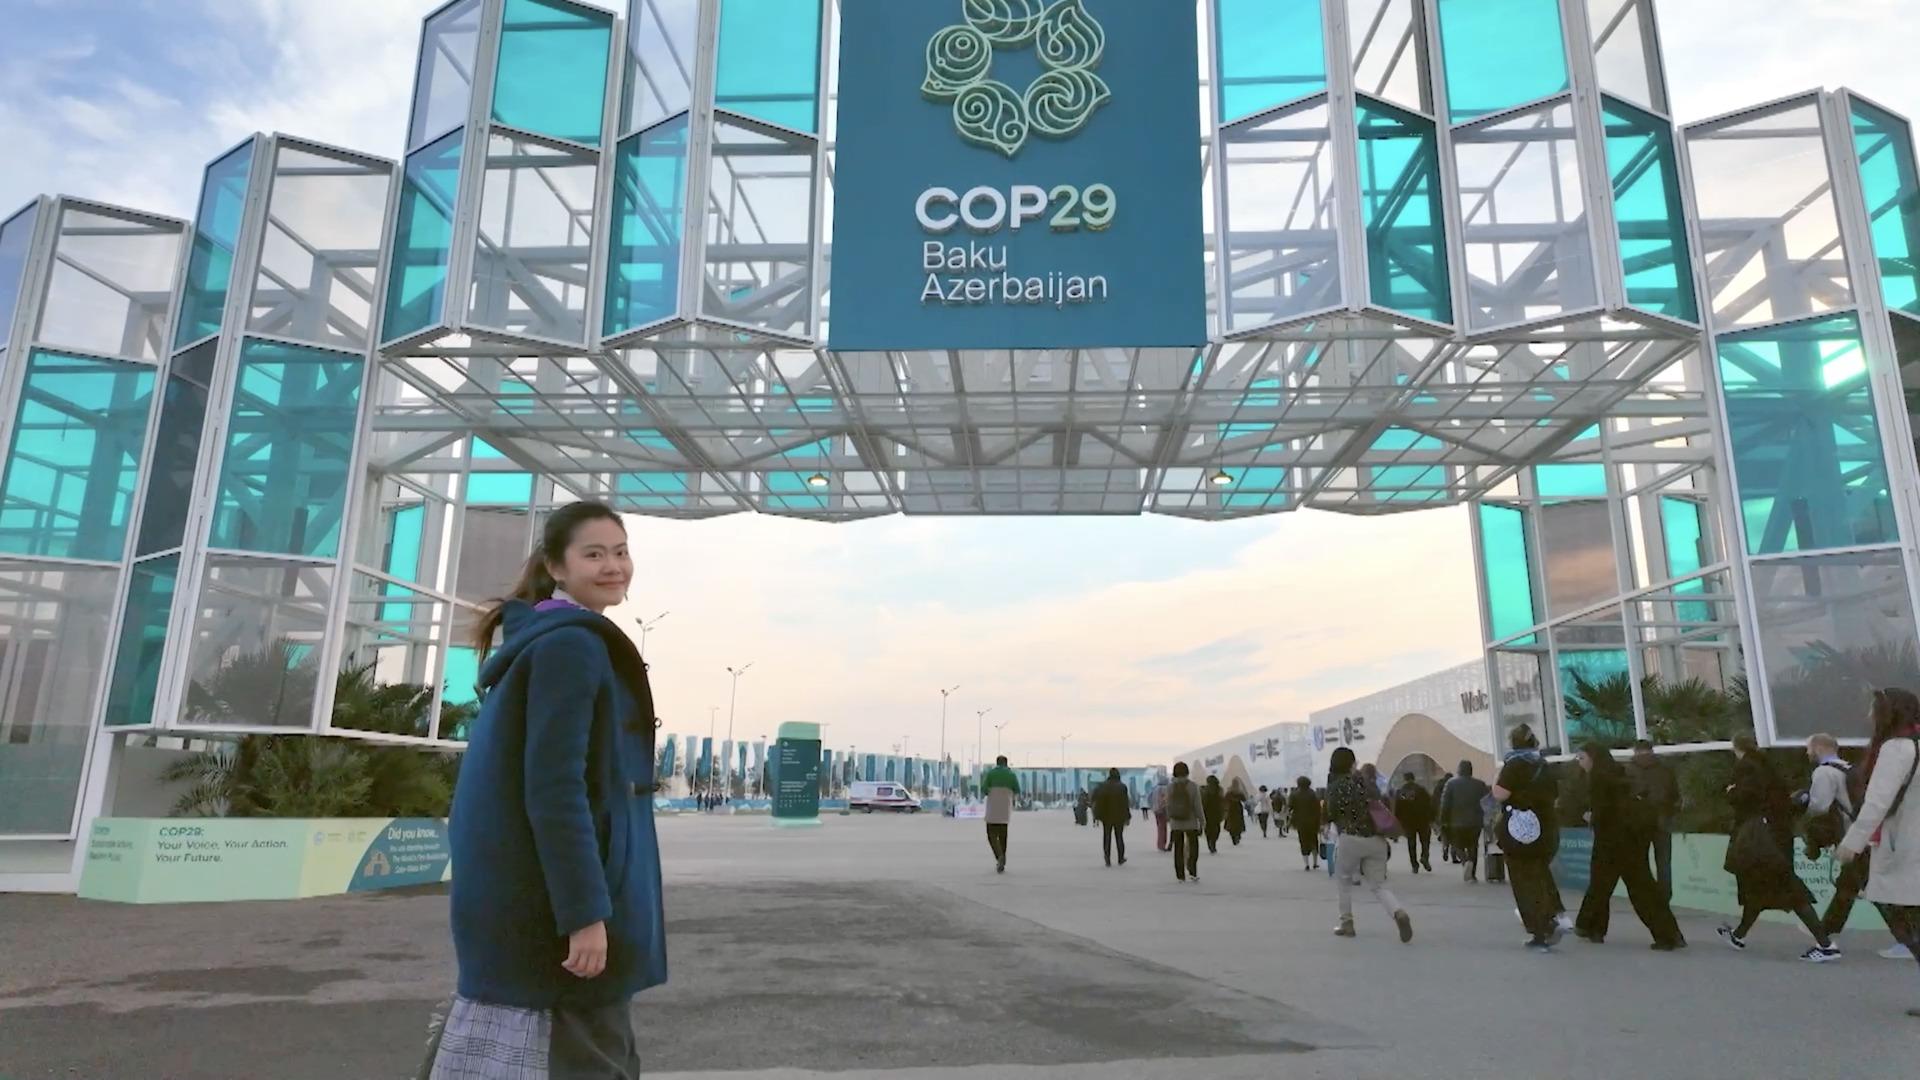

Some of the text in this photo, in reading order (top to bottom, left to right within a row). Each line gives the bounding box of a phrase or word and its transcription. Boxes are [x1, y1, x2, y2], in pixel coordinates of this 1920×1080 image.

[915, 183, 1117, 230] COP29
[922, 241, 1008, 271] Baku
[920, 271, 1108, 307] Azerbaijan
[158, 841, 182, 850] Your
[224, 840, 249, 849] Your
[388, 827, 402, 840] Did
[402, 829, 417, 842] you
[155, 854, 181, 863] Your
